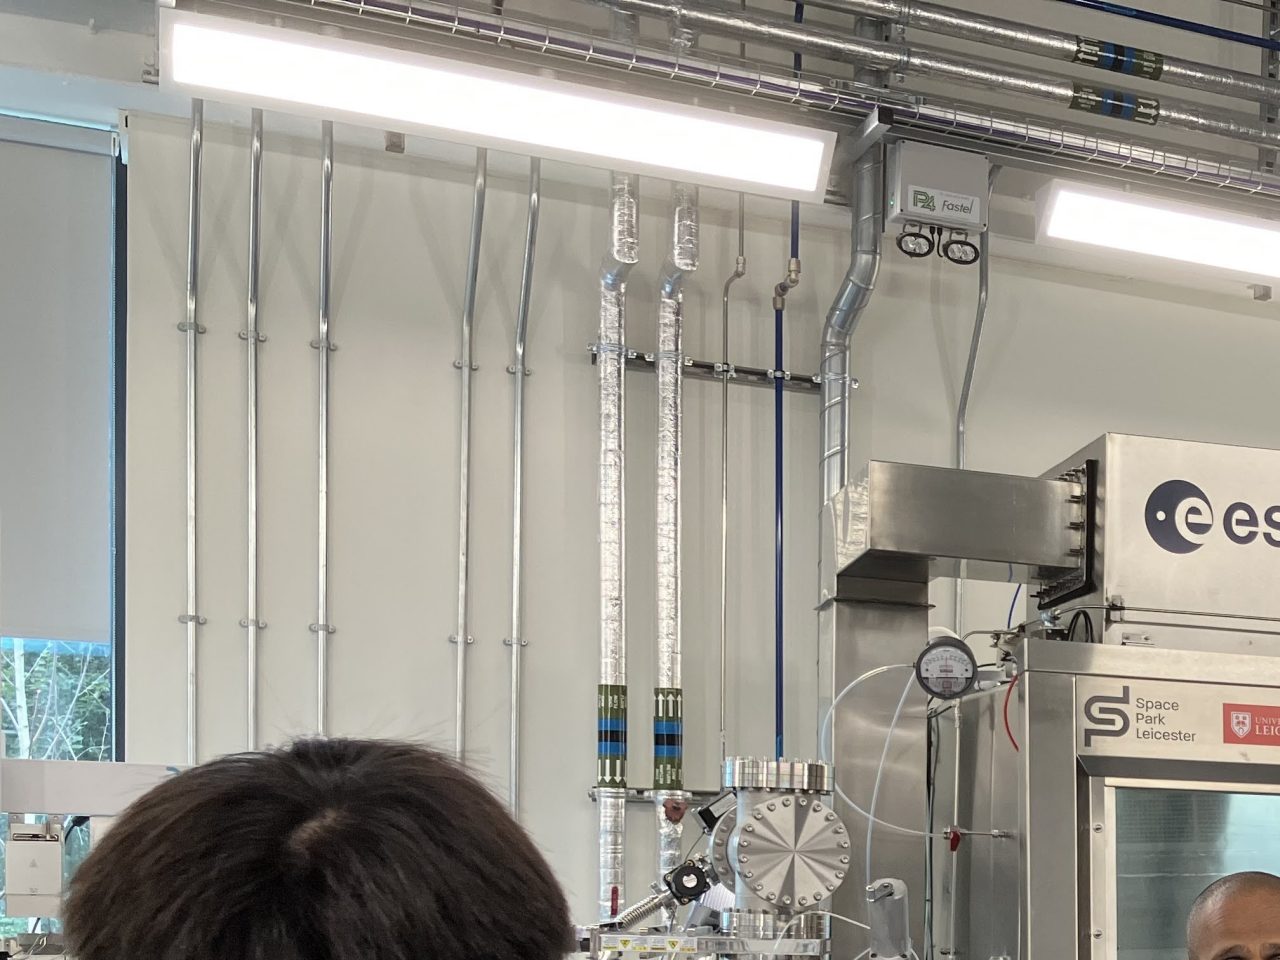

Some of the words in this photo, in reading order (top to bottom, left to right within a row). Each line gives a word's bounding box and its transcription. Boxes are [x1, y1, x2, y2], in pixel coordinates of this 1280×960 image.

[942, 199, 974, 214] Fastel
[1136, 697, 1179, 712] Space
[1136, 713, 1166, 726] Park
[1136, 728, 1197, 742] Leicester
